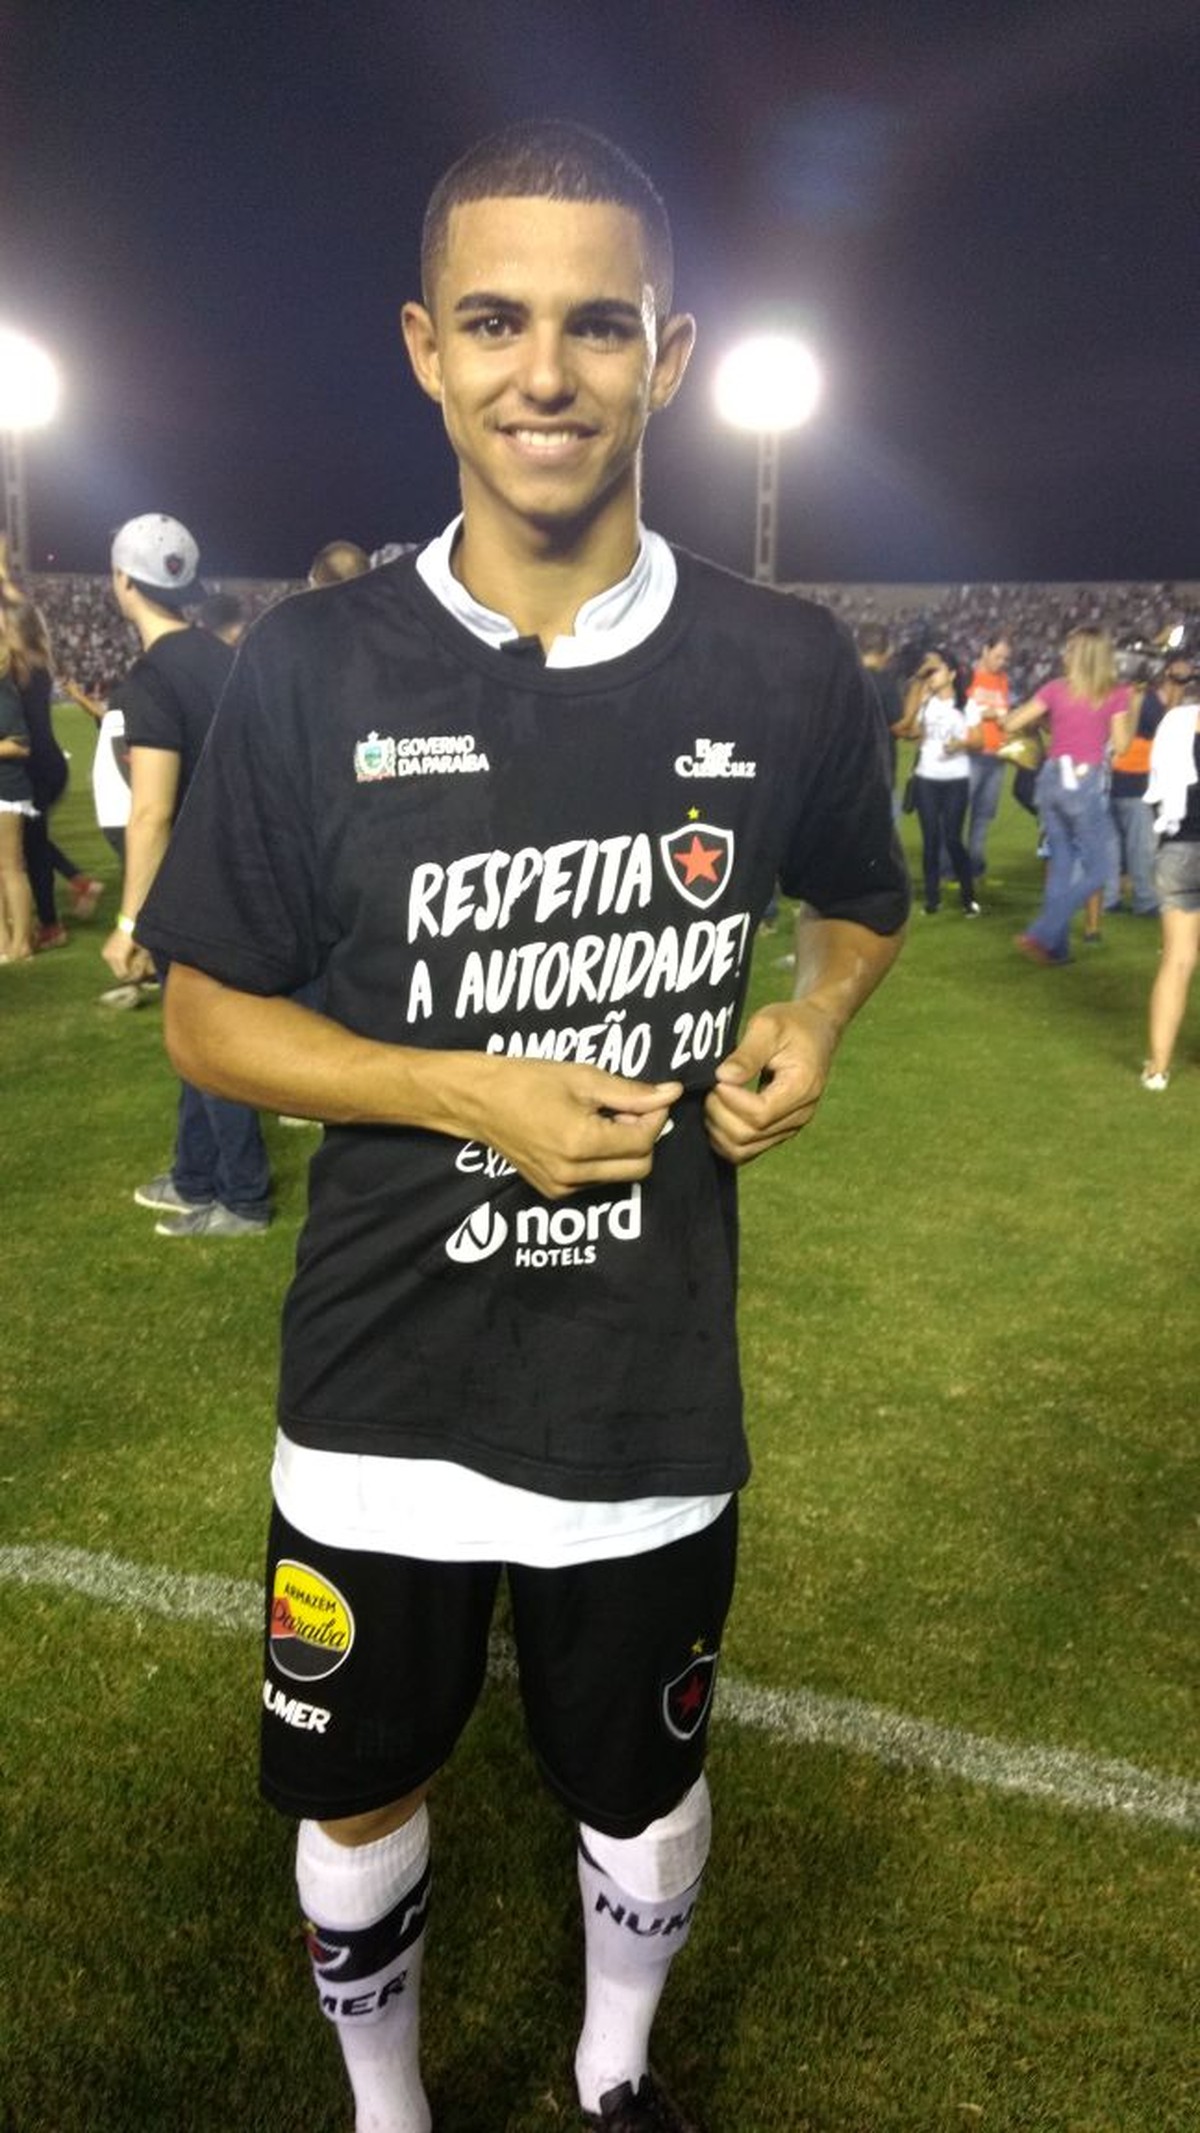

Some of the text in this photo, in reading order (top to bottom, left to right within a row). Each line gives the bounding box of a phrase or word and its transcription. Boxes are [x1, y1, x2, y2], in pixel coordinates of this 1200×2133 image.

[398, 735, 475, 757] GOVERNO
[398, 758, 421, 776] DA
[407, 833, 653, 944] RESPEITA
[407, 911, 751, 1023] A AUTORIDADE!
[516, 1183, 641, 1245] nord
[515, 1245, 597, 1268] HOTELS
[263, 1679, 332, 1734] UMER
